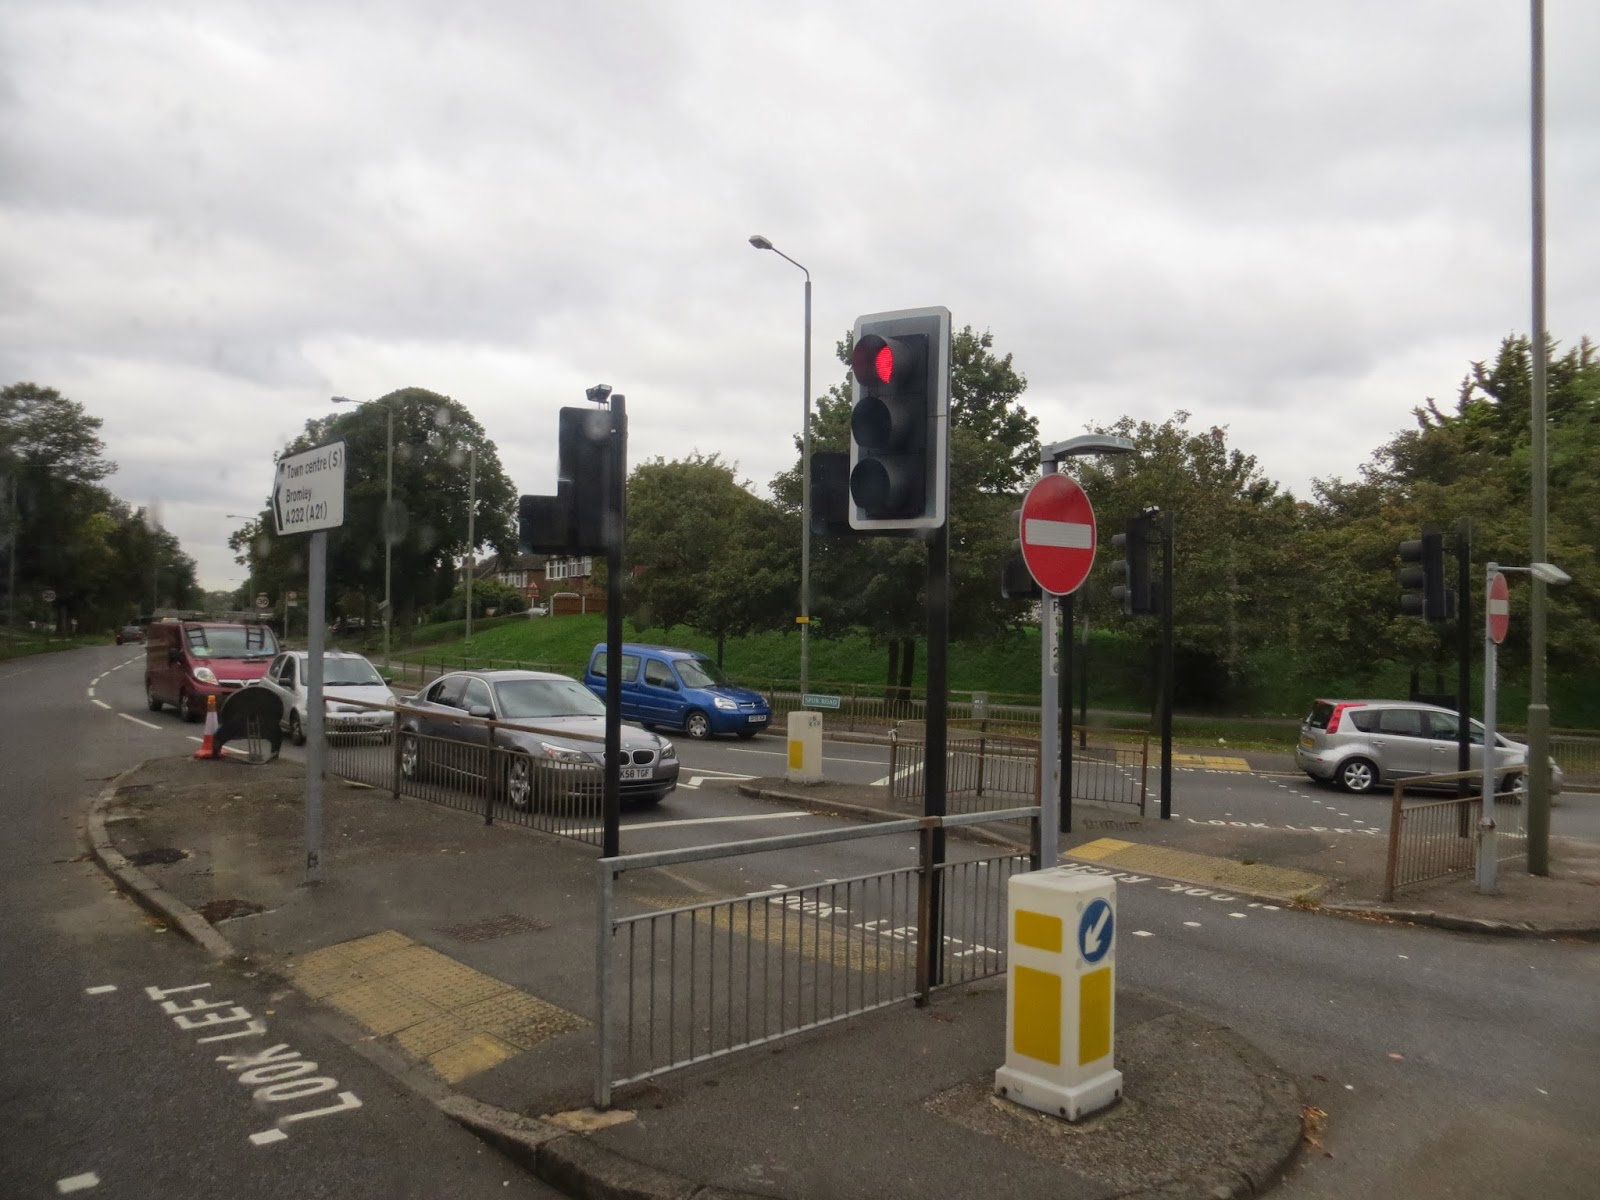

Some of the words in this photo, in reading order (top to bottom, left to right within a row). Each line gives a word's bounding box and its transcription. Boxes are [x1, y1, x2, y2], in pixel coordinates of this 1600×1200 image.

[287, 464, 304, 479] Town
[305, 457, 327, 475] centre
[328, 447, 343, 470] (S)
[286, 486, 312, 503] Bromley
[285, 506, 304, 524] A232
[306, 500, 328, 523] (A21)
[821, 698, 838, 706] ROAD
[620, 769, 635, 778] K58
[1187, 818, 1270, 829] LOOK
[1284, 824, 1381, 835] LEFT
[145, 982, 267, 1044] LEFT
[215, 1043, 363, 1125] LOOK
